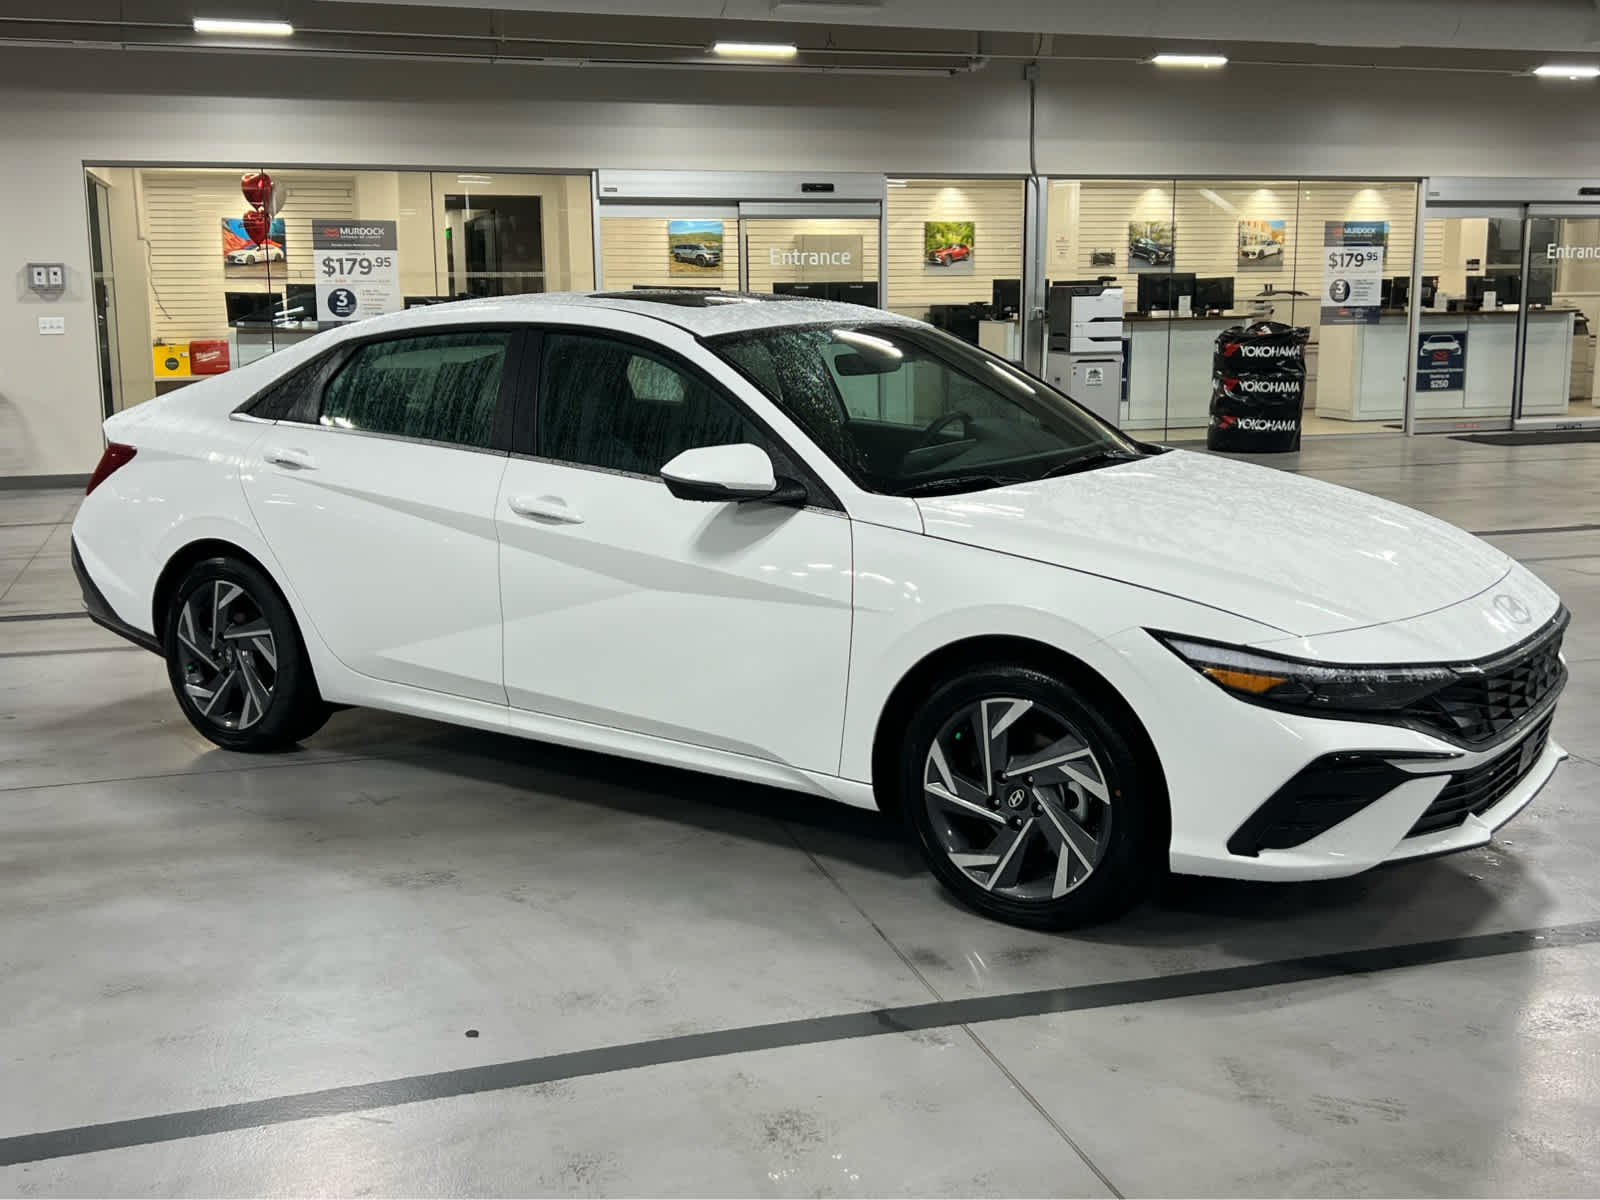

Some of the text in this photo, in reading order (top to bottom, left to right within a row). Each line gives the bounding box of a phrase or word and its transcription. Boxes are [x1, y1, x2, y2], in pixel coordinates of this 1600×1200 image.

[340, 227, 385, 236] MURDOCK
[769, 247, 851, 266] Entrance
[1328, 251, 1378, 269] $179.95
[322, 256, 392, 277] $179.95
[1335, 280, 1345, 295] 3
[335, 290, 350, 307] 3
[1240, 344, 1301, 358] YOKOHAMA
[1240, 380, 1300, 393] YOKOHAMA
[1237, 417, 1296, 431] YOKOHAMA
